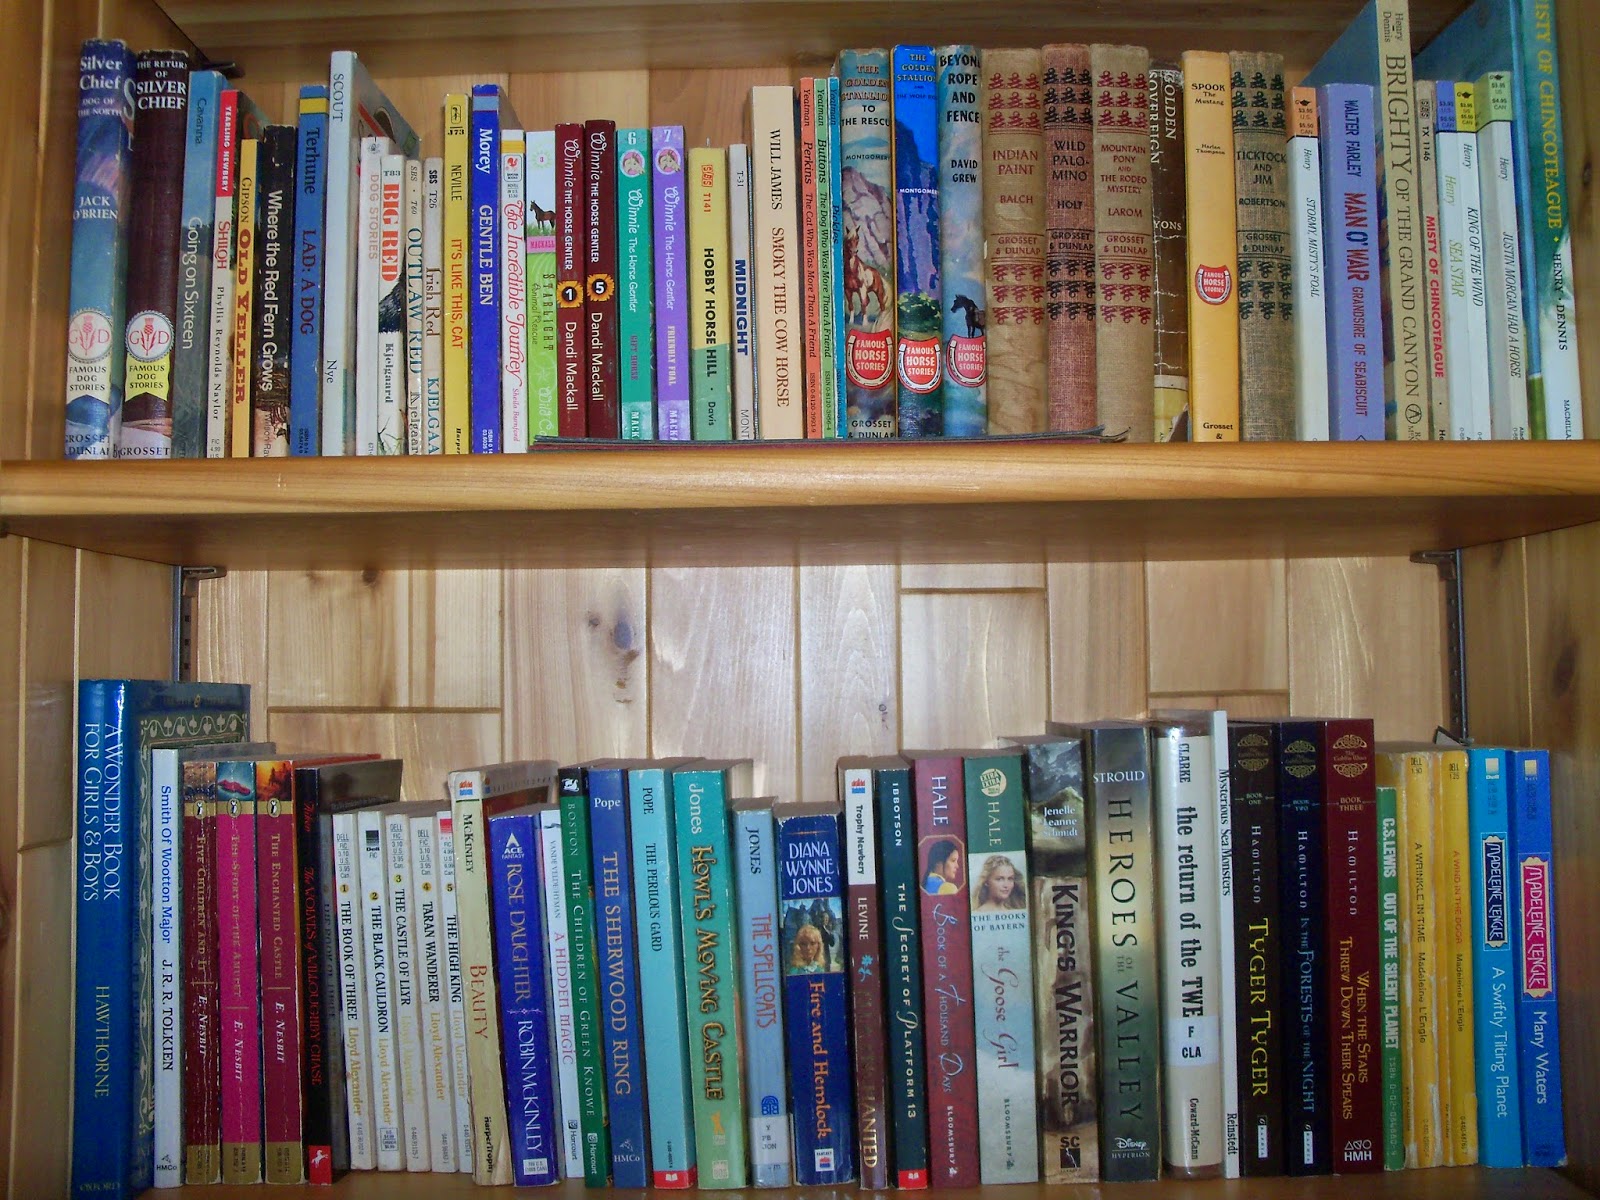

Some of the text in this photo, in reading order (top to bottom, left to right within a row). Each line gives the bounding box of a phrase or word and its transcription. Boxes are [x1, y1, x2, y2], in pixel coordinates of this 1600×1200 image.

[80, 56, 123, 71] Silver
[80, 75, 122, 91] Chief
[947, 73, 978, 87] ROPE
[137, 81, 186, 95] SILVER
[138, 96, 185, 110] CHIEF
[332, 73, 345, 122] SCOUT
[951, 91, 976, 104] AND
[1191, 82, 1225, 91] SPOOK
[195, 98, 207, 145] Cavanna
[224, 106, 232, 147] YEARLING
[946, 109, 980, 124] FENCE
[474, 128, 493, 174] Morey
[992, 149, 1038, 161] INDIAN
[1344, 100, 1361, 177] WALTER FARLEY
[303, 128, 322, 194] Terhune
[770, 130, 782, 210] WILL JAMES
[802, 141, 813, 184] Perkins
[817, 139, 827, 183] Buttons
[950, 159, 978, 169] DAVID
[952, 173, 977, 183] GREW
[998, 163, 1034, 176] PAINT
[80, 195, 110, 207] JACK
[239, 177, 252, 223] GIPSON
[450, 164, 463, 202] NEVILLE
[1000, 194, 1034, 205] BALCH
[1057, 200, 1082, 209] HOLT
[382, 183, 400, 281] BIG RED
[1108, 207, 1143, 218] LAROM
[1386, 54, 1420, 398] BRIGHTY OF THE GRAND CANYON
[451, 239, 462, 260] IT'S
[478, 204, 493, 306] GENTLE BEN
[183, 216, 203, 349] Going on Sixteen
[261, 190, 283, 391] Where the Red Fern Grows
[451, 264, 462, 289] LIKE
[1425, 216, 1444, 378] MISTY OF CHINCOTEAGUE
[235, 229, 251, 404] OLD YELLER
[703, 248, 718, 377] HOBBY HORSE HILL
[734, 260, 749, 356] MIDNIGHT
[772, 227, 790, 407] SMOKY THE COW HORSE
[1553, 253, 1567, 351] HENRY DENNIS
[213, 287, 224, 421] Phyllis Reynolds Naylor
[451, 327, 463, 349] CAT
[590, 312, 603, 401] Dandi Mackall
[855, 339, 885, 350] FAMOUS
[855, 350, 886, 361] HORSE
[1352, 287, 1368, 416] GRANDSIRE OF SEABISCUIT
[129, 363, 165, 374] FAMOUS
[129, 380, 164, 389] STORIES
[137, 373, 156, 381] DOG
[326, 360, 337, 384] Nye
[856, 361, 885, 371] STORIES
[707, 401, 716, 427] Davis
[1203, 422, 1233, 431] Grosset
[1092, 771, 1145, 782] STROUD
[1178, 743, 1190, 783] CLARKE
[83, 723, 102, 901] FOR GIRLS & BOYS
[104, 723, 123, 900] A WONDER BOOK
[594, 797, 621, 810] Pope
[688, 782, 702, 835] Jones
[892, 782, 902, 847] IBBOTSON
[932, 776, 948, 827] HALE
[1176, 806, 1198, 836] the
[504, 846, 523, 854] ACE
[746, 827, 762, 875] JONES
[788, 842, 830, 859] DIANA
[855, 804, 865, 874] Trophy Newbery
[1219, 769, 1232, 896] Mysterious Sea Monsters
[1382, 818, 1396, 878] C.S.LEWIS
[160, 785, 172, 943] Smith Of Wootton Major
[786, 859, 833, 876] WYNNE
[789, 876, 832, 894] JONES
[1109, 799, 1138, 947] HEROES
[1178, 844, 1198, 905] return
[271, 833, 283, 979] THE ENCHANTED CASTLE
[858, 897, 868, 940] LEVINE
[1180, 911, 1202, 930] of
[507, 864, 531, 1002] ROSE DAUGHTER
[1181, 939, 1202, 967] the
[602, 853, 632, 1096] THE SHERWOOD RING
[162, 959, 173, 1071] J. R. R. TOLKIEN
[469, 965, 489, 1040] BEAUTY
[1051, 884, 1083, 1110] KING'S WARRIOR
[1249, 917, 1271, 1097] TYGER TYGER
[95, 985, 110, 1097] HAWTHORNE
[276, 1019, 286, 1062] NESBIT
[1116, 981, 1142, 1121] VALLEY
[1182, 1046, 1201, 1059] CLA
[1187, 1025, 1194, 1038] F
[1490, 967, 1509, 1118] A Swiftly Tilting Planet
[809, 980, 832, 1139] Fire and Hemlock
[1530, 1011, 1549, 1105] Many Waters
[1343, 1151, 1372, 1161] HMH
